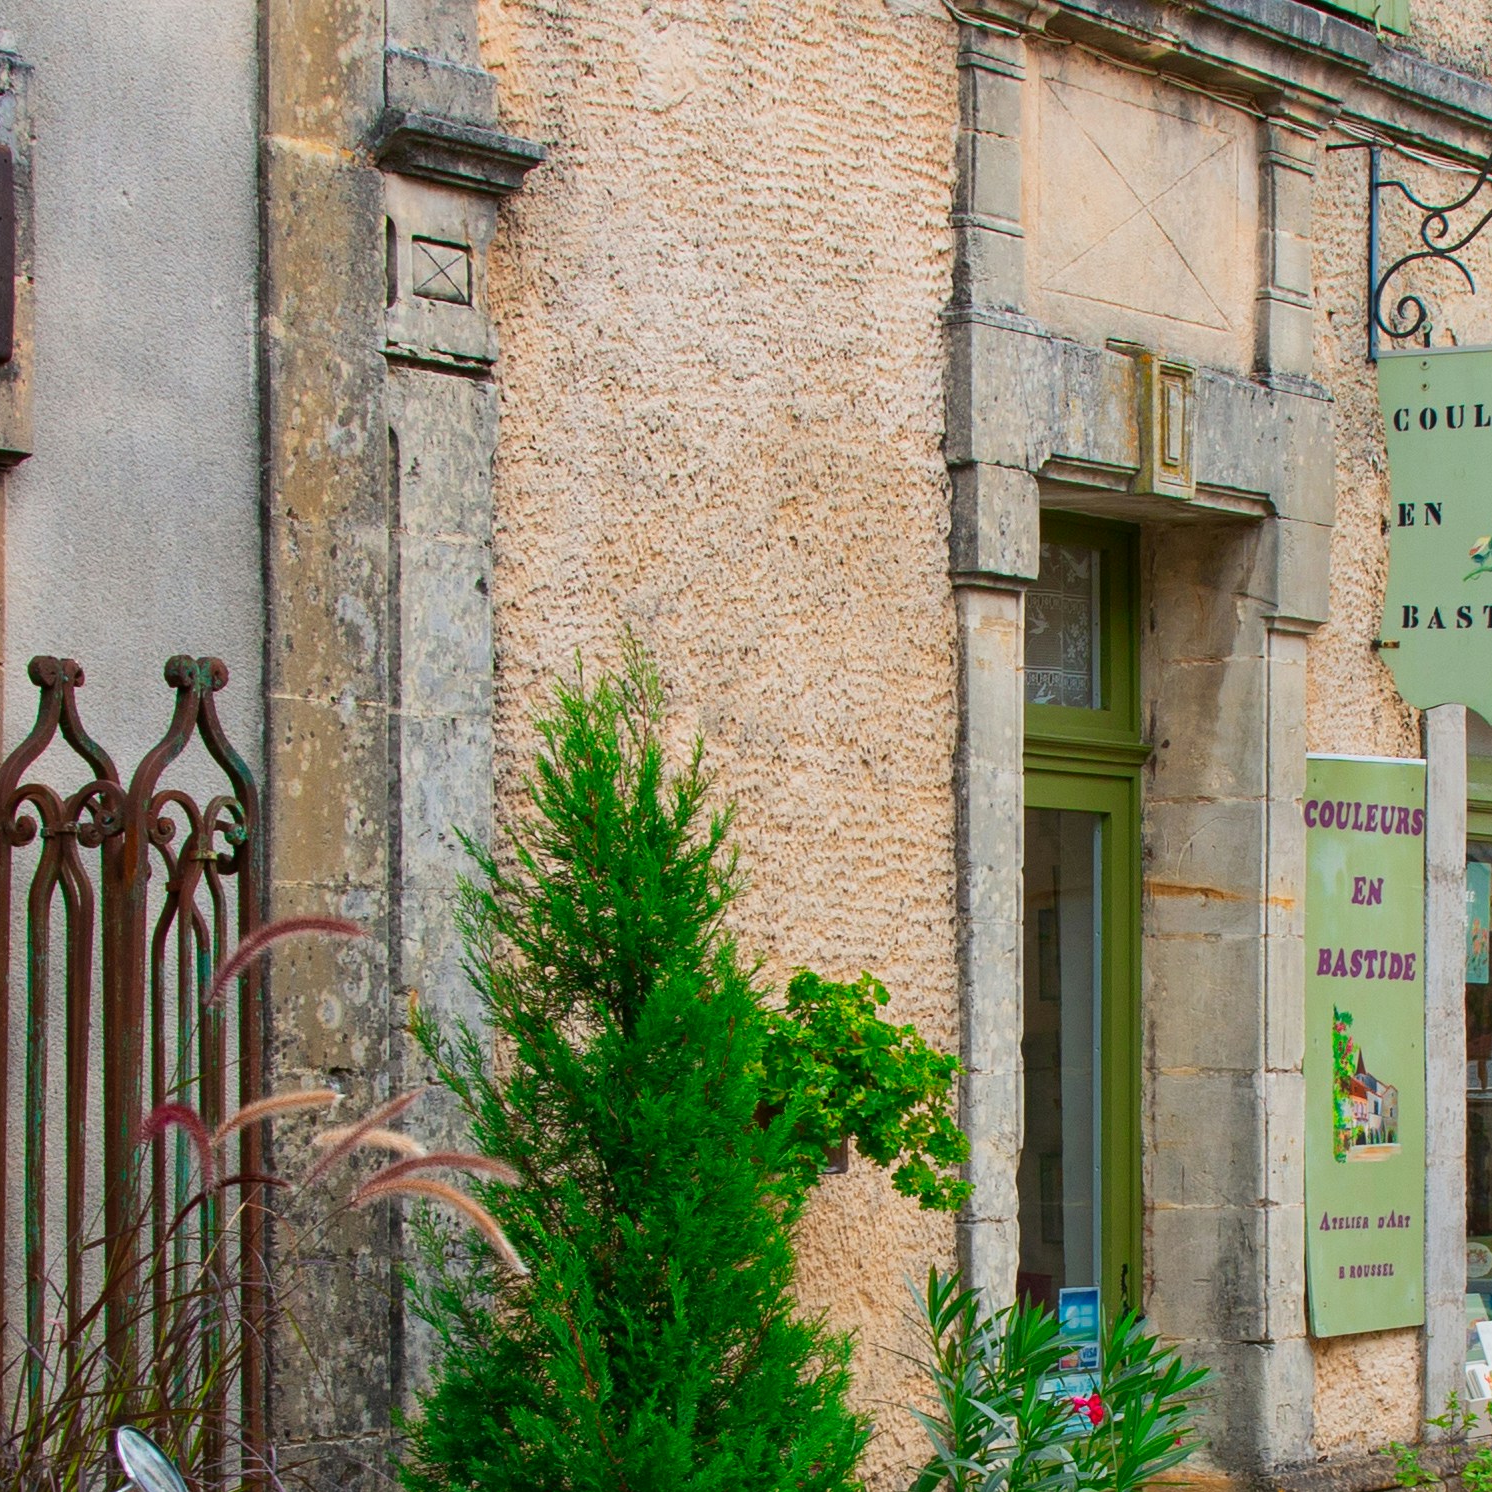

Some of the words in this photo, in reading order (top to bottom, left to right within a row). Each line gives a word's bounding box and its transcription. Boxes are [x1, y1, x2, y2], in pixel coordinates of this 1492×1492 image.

[1398, 502, 1443, 527] EN
[1304, 800, 1425, 836] COULEURS
[1351, 877, 1384, 906] EN
[1316, 948, 1416, 981] BASTIDE
[1339, 1266, 1345, 1279] B
[1349, 1262, 1394, 1279] ROUSSEL
